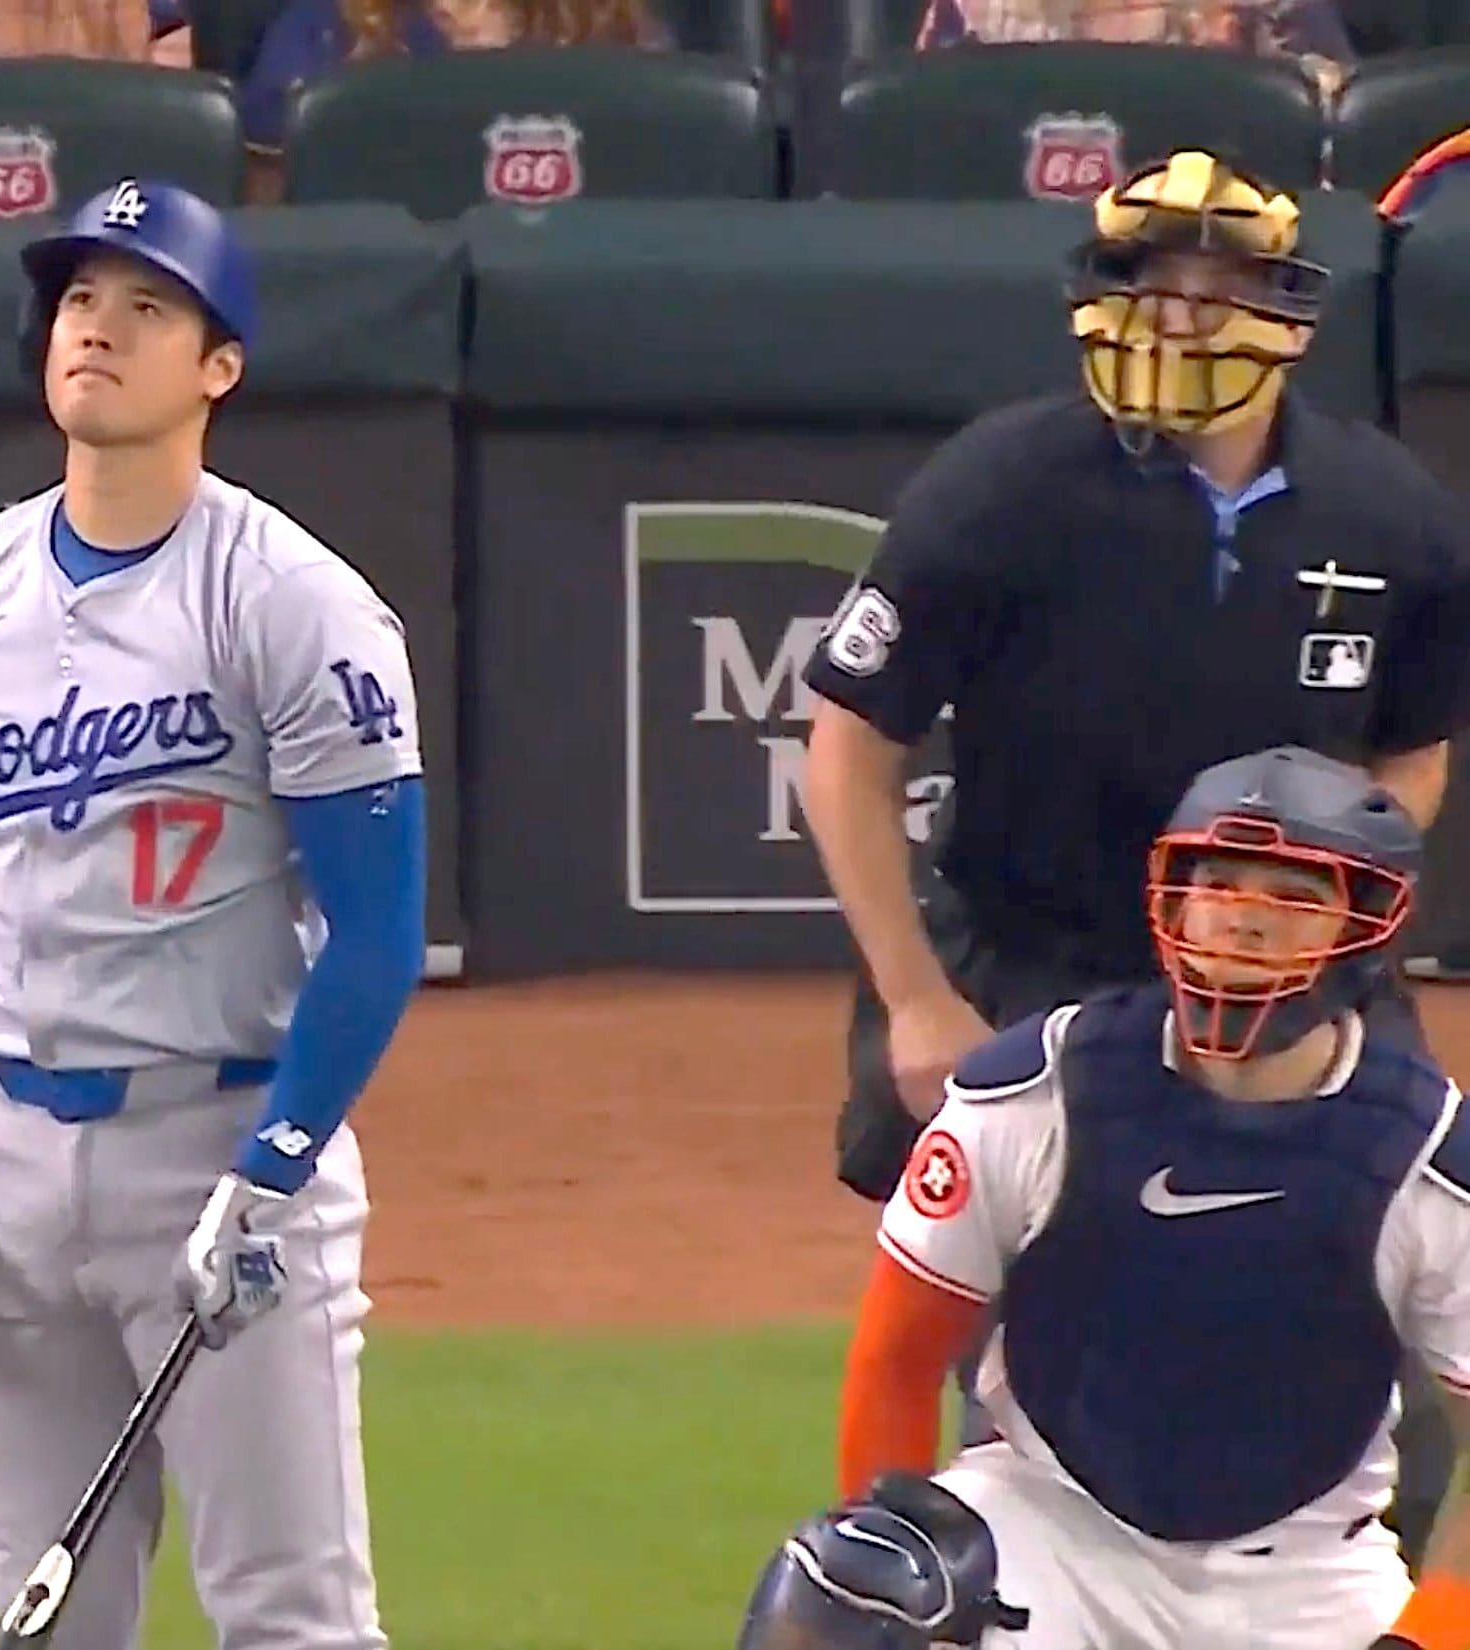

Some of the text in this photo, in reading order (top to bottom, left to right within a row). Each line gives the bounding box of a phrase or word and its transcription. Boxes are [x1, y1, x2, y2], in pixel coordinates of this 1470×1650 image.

[503, 152, 563, 190] 66
[1043, 151, 1104, 187] 66
[105, 181, 148, 228] LA
[330, 659, 403, 745] LA
[129, 797, 225, 907] 17
